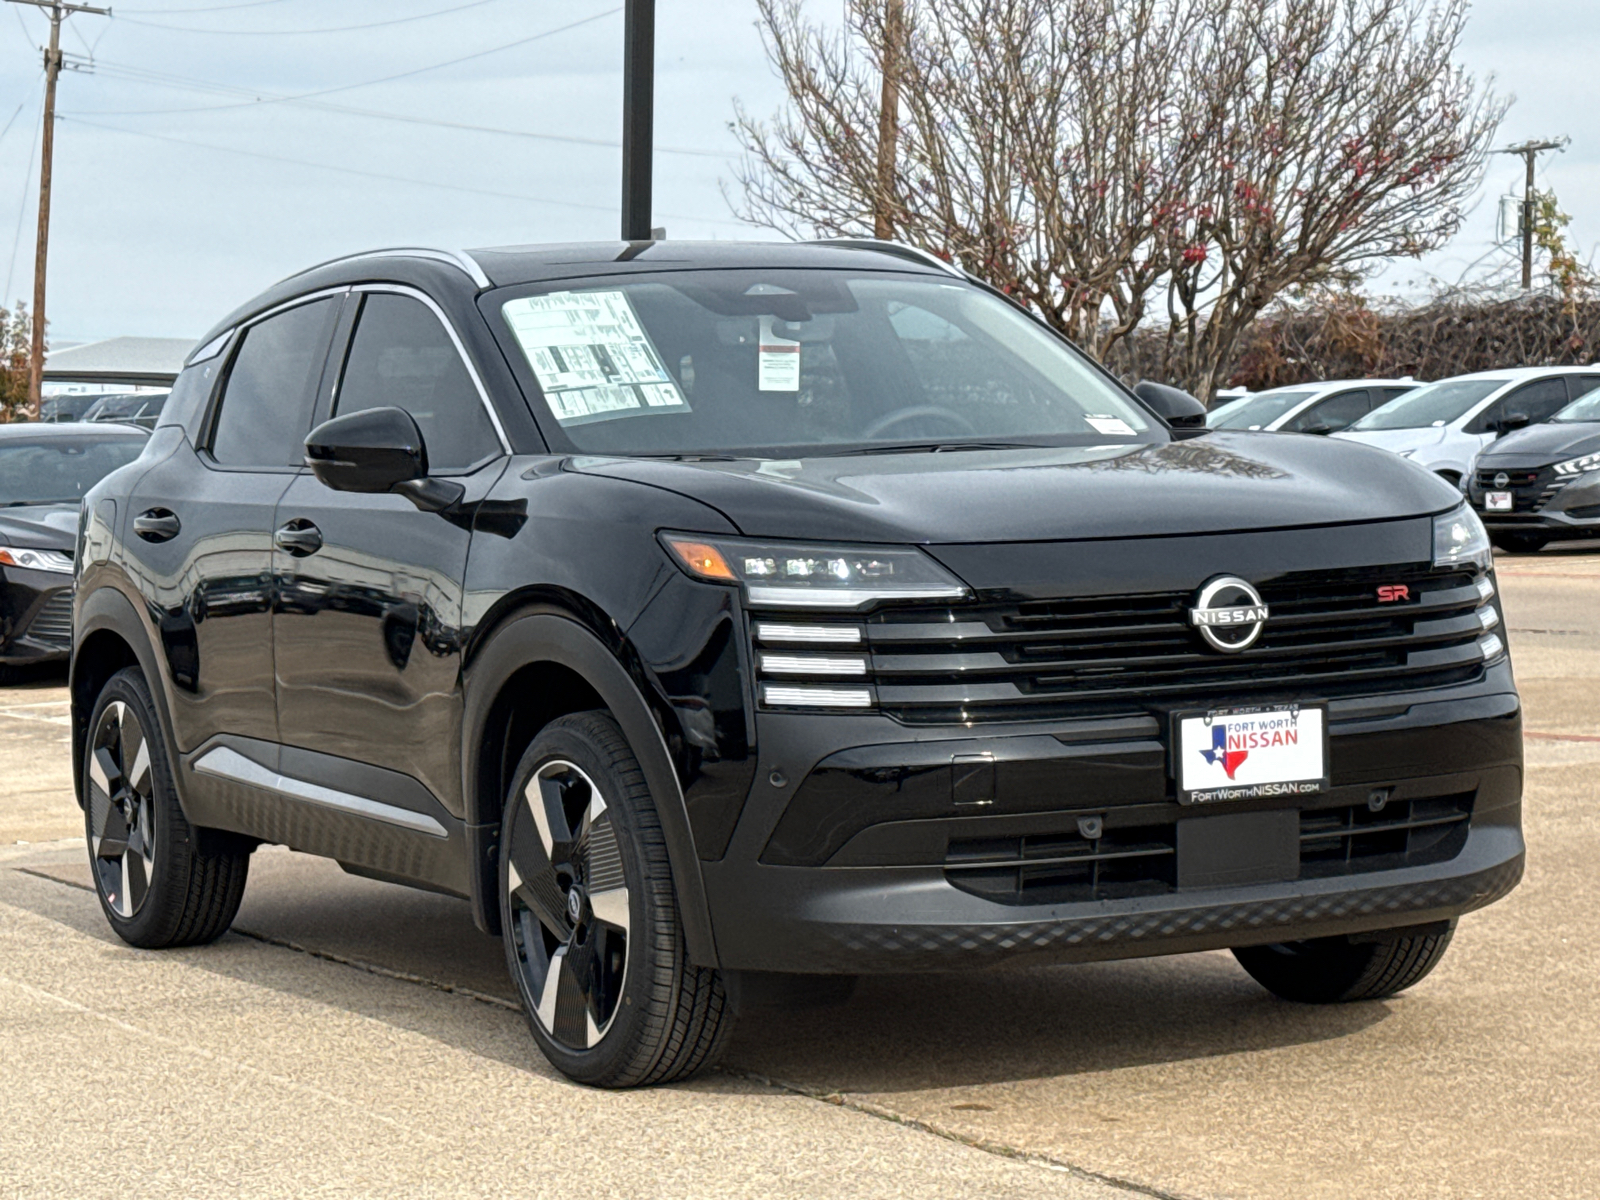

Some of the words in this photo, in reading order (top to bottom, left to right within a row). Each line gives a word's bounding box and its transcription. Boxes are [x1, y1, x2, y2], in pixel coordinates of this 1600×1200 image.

[1377, 584, 1410, 602] SR
[1195, 607, 1268, 624] NISSAN
[1228, 721, 1255, 733] FORT
[1259, 718, 1297, 730] WORTH
[1228, 730, 1298, 750] NISSAN
